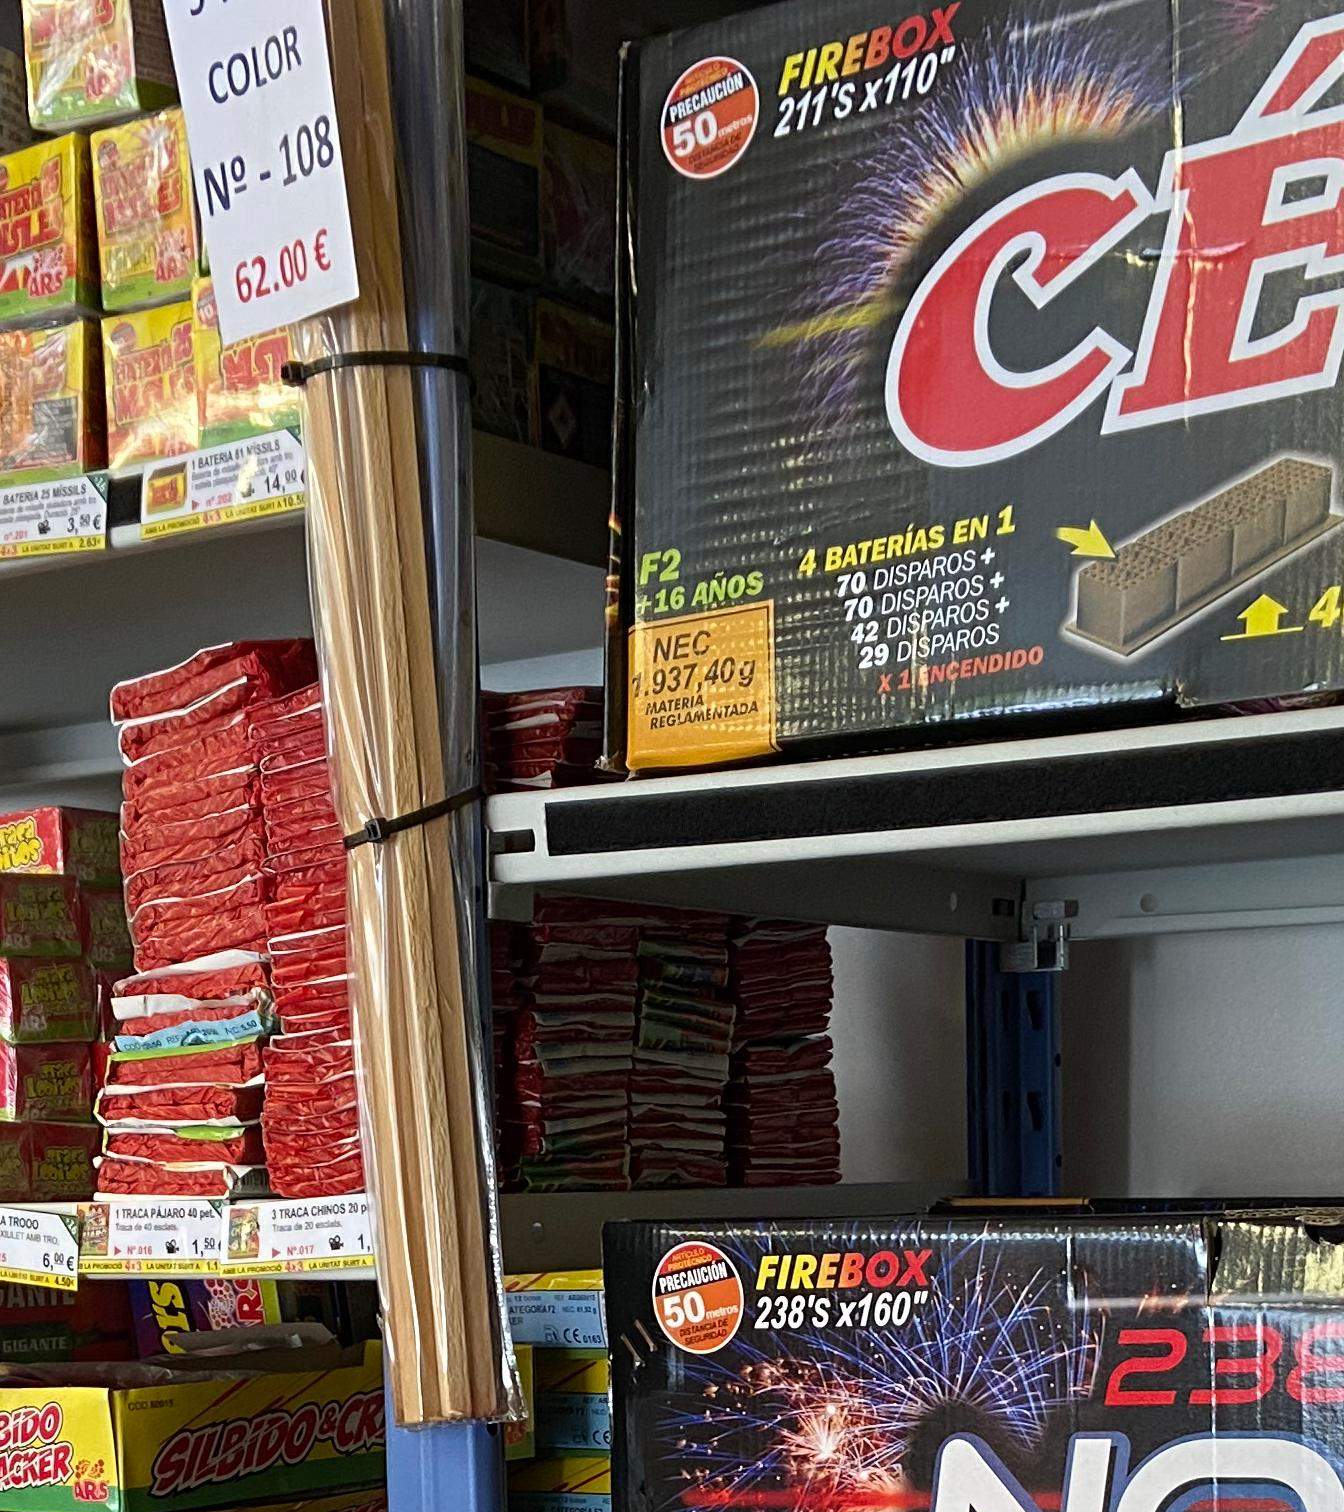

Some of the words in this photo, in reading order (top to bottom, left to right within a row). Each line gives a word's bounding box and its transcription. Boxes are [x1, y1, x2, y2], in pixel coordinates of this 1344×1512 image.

[207, 26, 303, 104] COLOR
[777, 3, 958, 97] FIREBOX
[669, 71, 744, 123] PRECAUCIÓN
[774, 80, 856, 138] 211'S
[671, 110, 718, 158] 50
[718, 114, 753, 138] metros
[202, 157, 248, 217] Nº
[279, 115, 335, 187] 108
[235, 238, 308, 304] 62.00
[314, 228, 331, 272] €
[3, 489, 39, 505] BATERIA
[41, 488, 51, 499] 25
[53, 484, 87, 499] MÍSSILS
[799, 550, 818, 576] 4
[824, 524, 946, 574] BATERÍAS
[951, 514, 992, 542] EN
[995, 505, 1016, 536] 1
[639, 549, 681, 585] F2
[836, 572, 867, 598] 70
[873, 551, 977, 590] DISPAROS
[637, 586, 685, 615] +16
[692, 571, 765, 606] AÑOS
[844, 596, 874, 621] 70
[881, 575, 984, 616] DISPAROS
[851, 622, 878, 645] 42
[887, 599, 990, 639] DISPAROS
[653, 630, 711, 663] NEC
[858, 644, 890, 669] 29
[897, 623, 1000, 663] DISPAROS
[633, 661, 735, 699] 1.937,40
[738, 659, 756, 689] g
[898, 672, 912, 690] 1
[916, 646, 1044, 687] ENCENDIDO
[645, 694, 705, 716] MATERIA
[650, 701, 759, 730] REGLAMENTADA
[122, 1208, 147, 1219] TRACA
[150, 1207, 186, 1219] PÁJARO
[187, 1208, 198, 1219] 40
[271, 1209, 277, 1220] 3
[280, 1206, 305, 1219] TRACA
[308, 1204, 346, 1218] CHINOS
[347, 1203, 359, 1214] 20
[659, 1262, 728, 1294] PRECAUCIÓN
[755, 1249, 933, 1291] FIREBOX
[663, 1291, 705, 1329] 50
[706, 1304, 738, 1320] metros
[679, 1322, 717, 1338] DISTANCIA
[718, 1318, 728, 1328] DE
[754, 1294, 832, 1329] 238'S
[684, 1328, 728, 1346] SEGURIDAD
